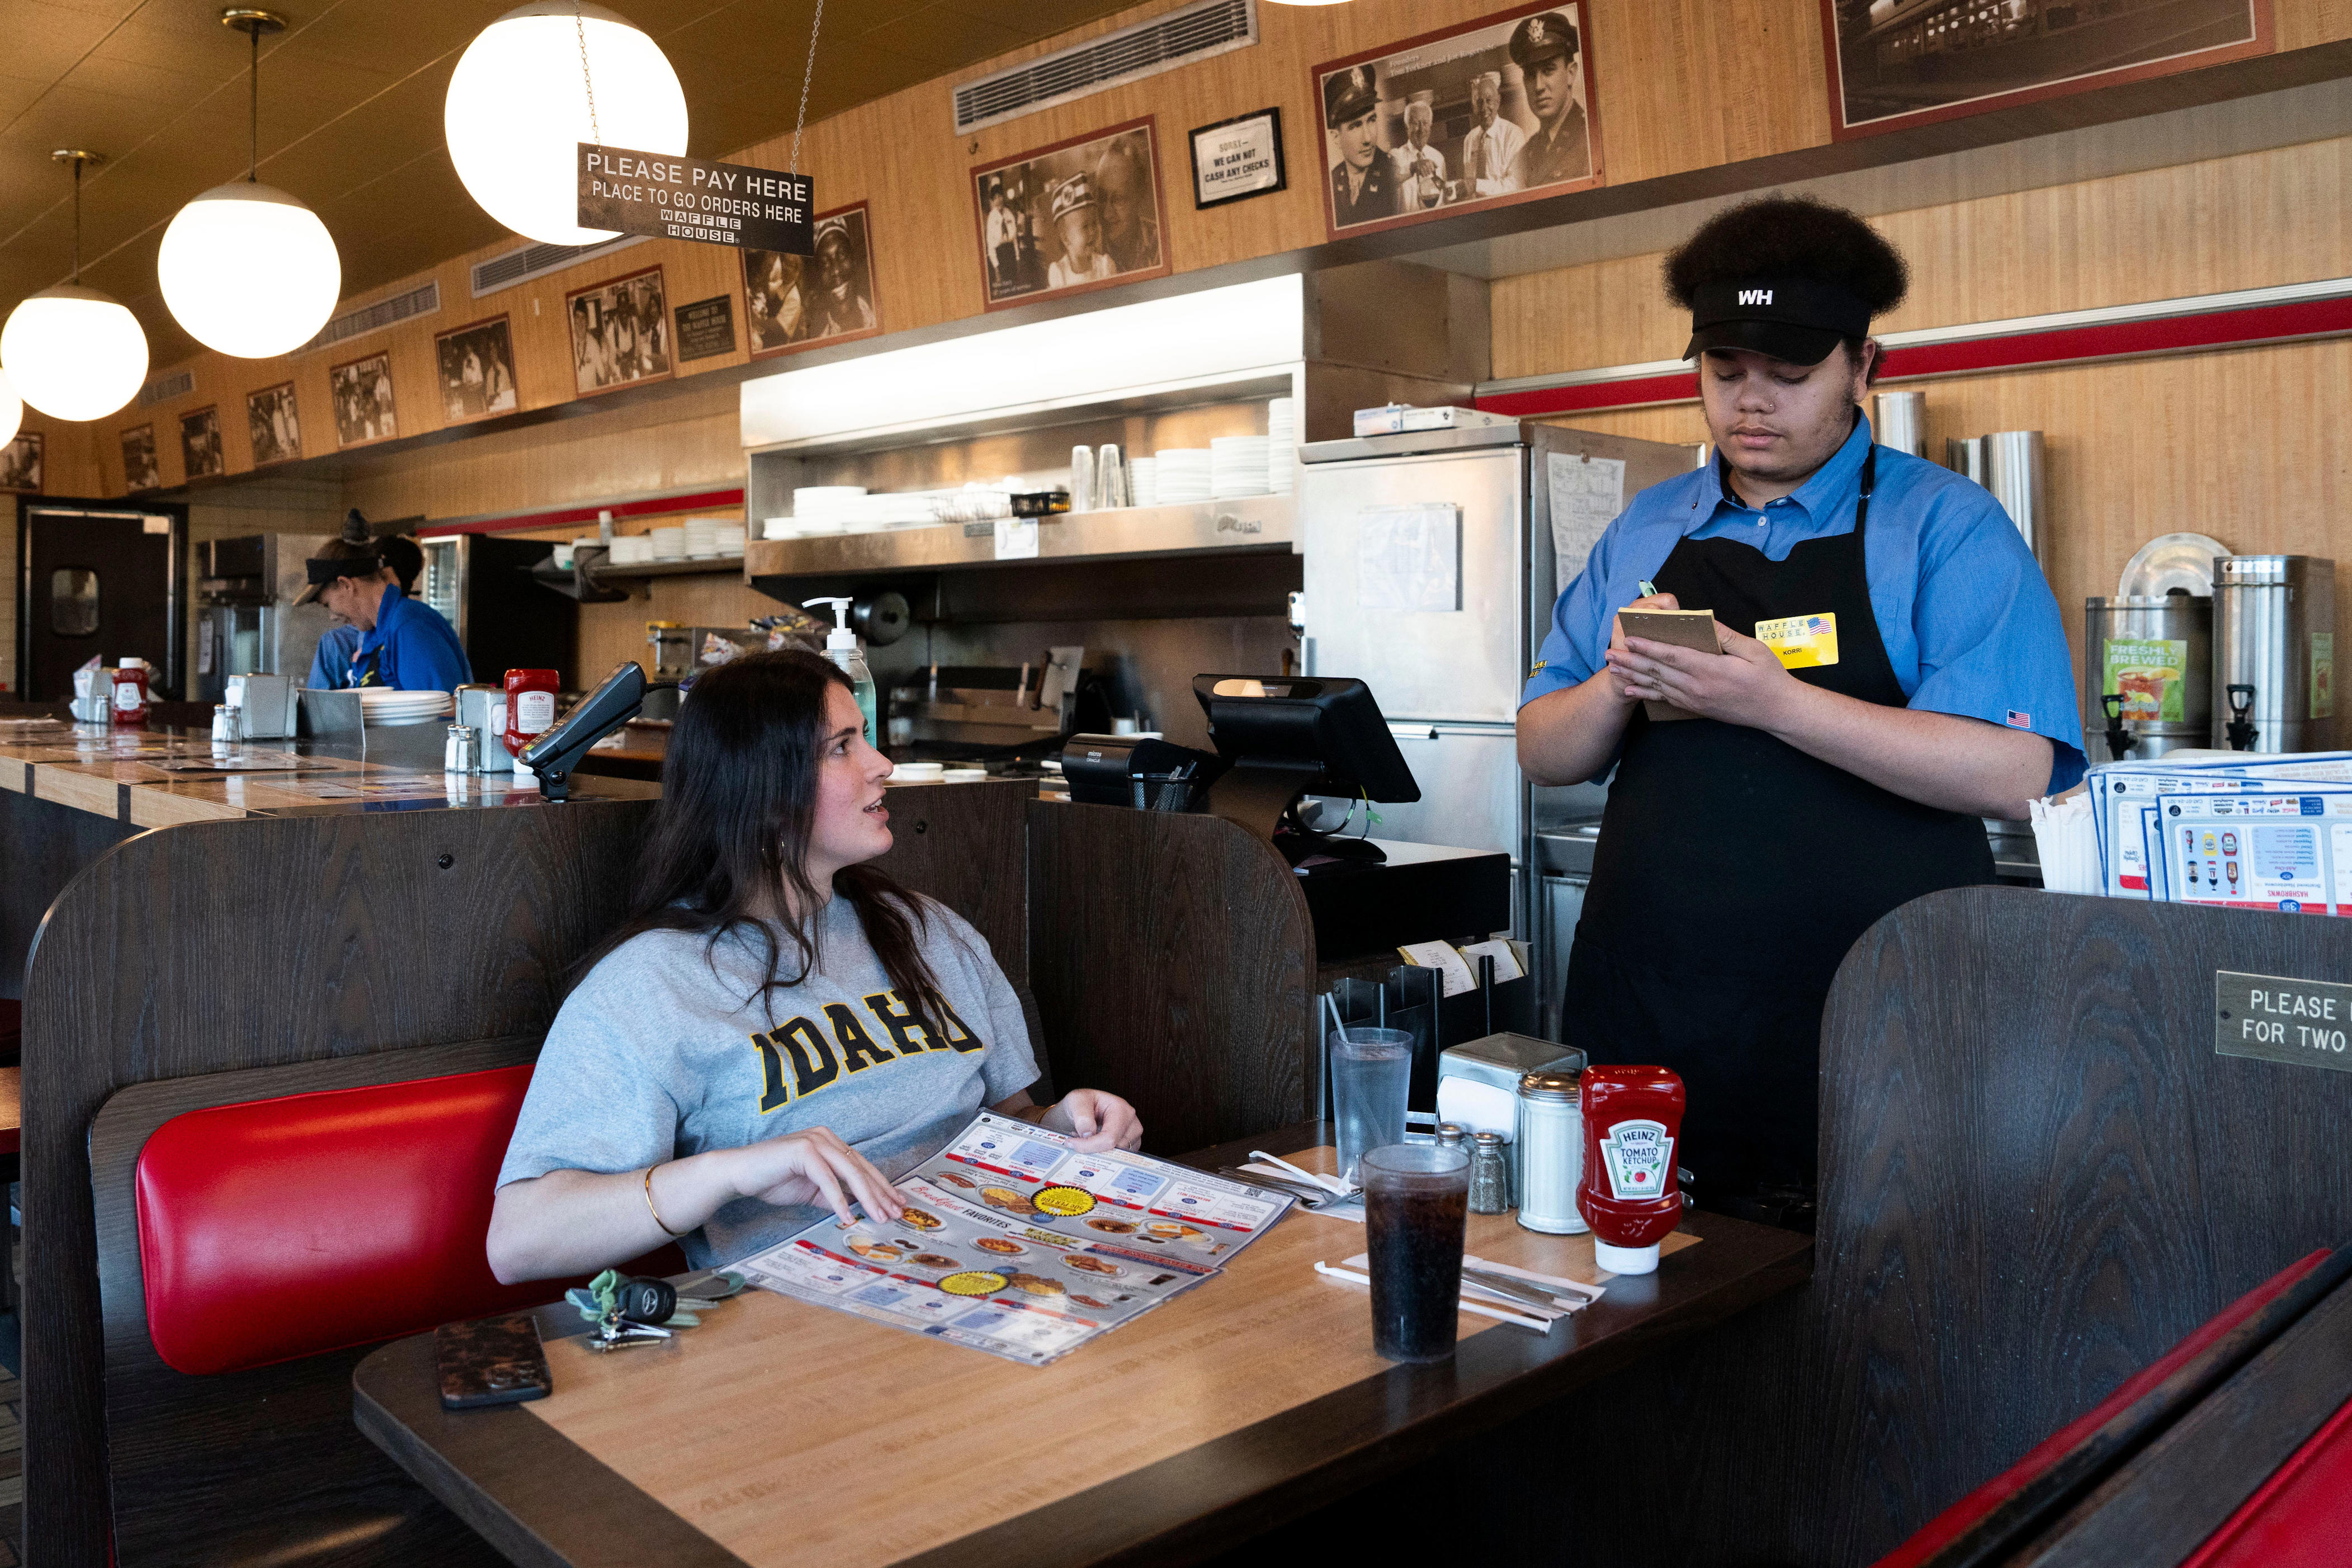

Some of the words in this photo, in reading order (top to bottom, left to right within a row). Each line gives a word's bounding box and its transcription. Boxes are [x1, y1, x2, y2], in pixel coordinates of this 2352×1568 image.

[1214, 157, 1225, 167] WE
[1226, 153, 1241, 163] CAN
[1243, 149, 1256, 159] NOT
[588, 153, 682, 184] PLEASE
[693, 168, 737, 190] PAY
[747, 177, 806, 202] HERE
[1205, 171, 1225, 183] CASH
[1227, 168, 1240, 178] ANY
[1243, 159, 1270, 173] CHECKS
[593, 181, 642, 202] PLACE
[648, 188, 668, 205] TO
[674, 191, 695, 209] GO
[701, 196, 760, 218] ORDERS
[766, 205, 802, 224] HERE
[661, 209, 741, 230] WAFFLE
[668, 225, 735, 243] HOUSE
[1739, 290, 1773, 305] WH
[1758, 620, 1805, 633] WAFFLE
[1763, 629, 1802, 640] HOUSE
[2110, 644, 2179, 657] FRESHLY
[2110, 654, 2179, 666] BREWED
[2251, 989, 2336, 1021] PLEASE
[2243, 1019, 2285, 1043] FOR
[2297, 1026, 2345, 1052] TWO
[750, 988, 984, 1114] IDAHO
[1623, 1131, 1655, 1142] HEINZ
[1621, 1147, 1657, 1157] TOMATO
[911, 1187, 964, 1210] Breakfast
[962, 1208, 1010, 1228] FAVORITES
